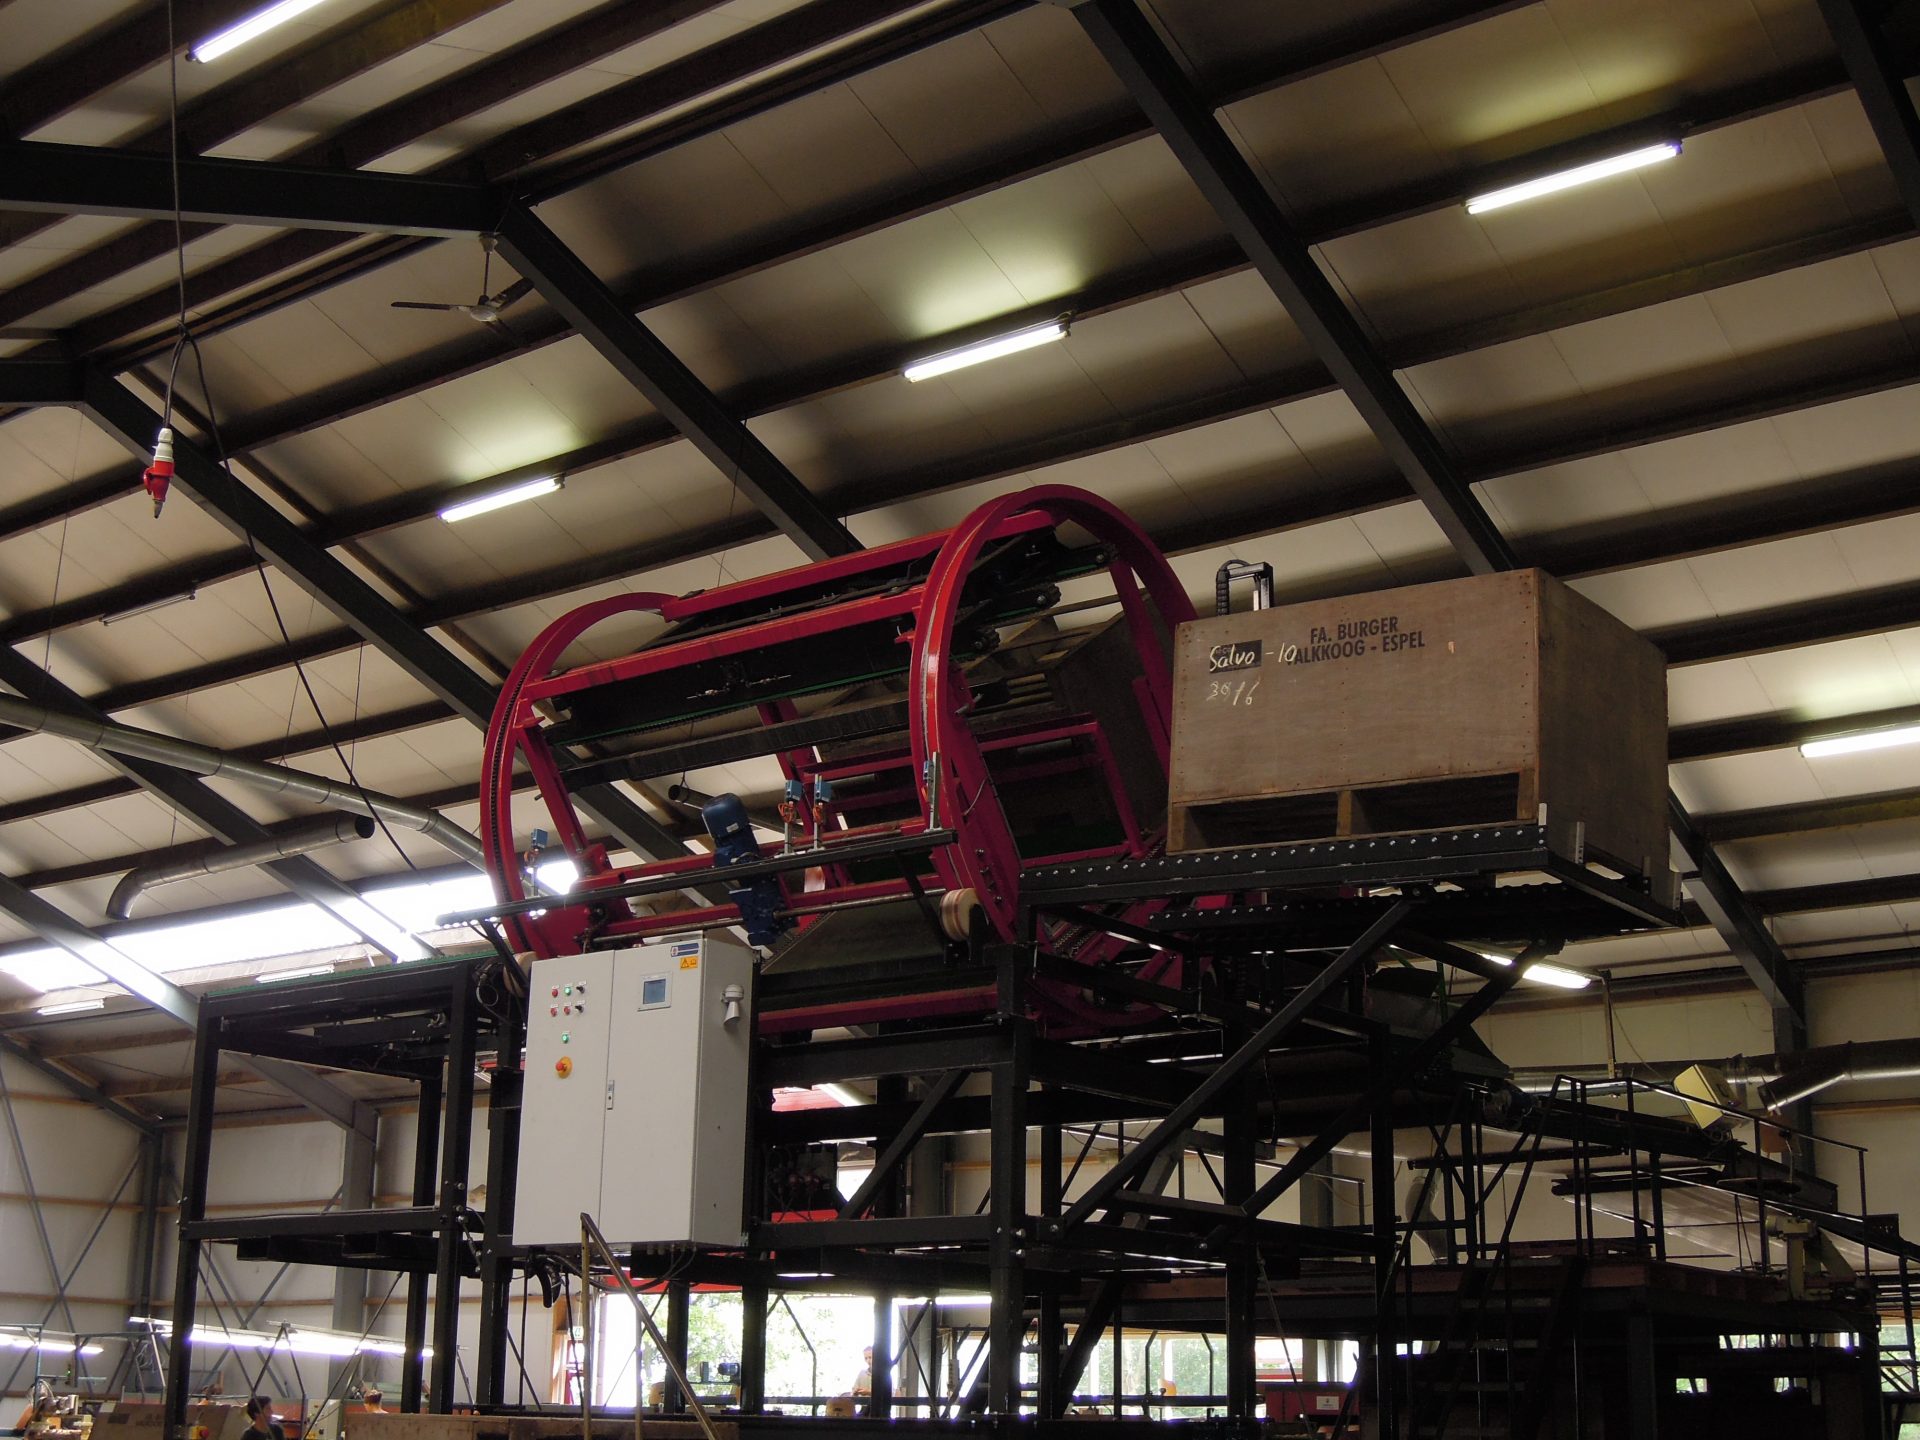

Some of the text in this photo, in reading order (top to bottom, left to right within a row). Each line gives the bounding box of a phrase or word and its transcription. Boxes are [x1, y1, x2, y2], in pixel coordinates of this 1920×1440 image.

[1310, 616, 1399, 645] FA. BURGER
[1382, 631, 1426, 653] ESPEL
[1209, 644, 1255, 672] Salvo
